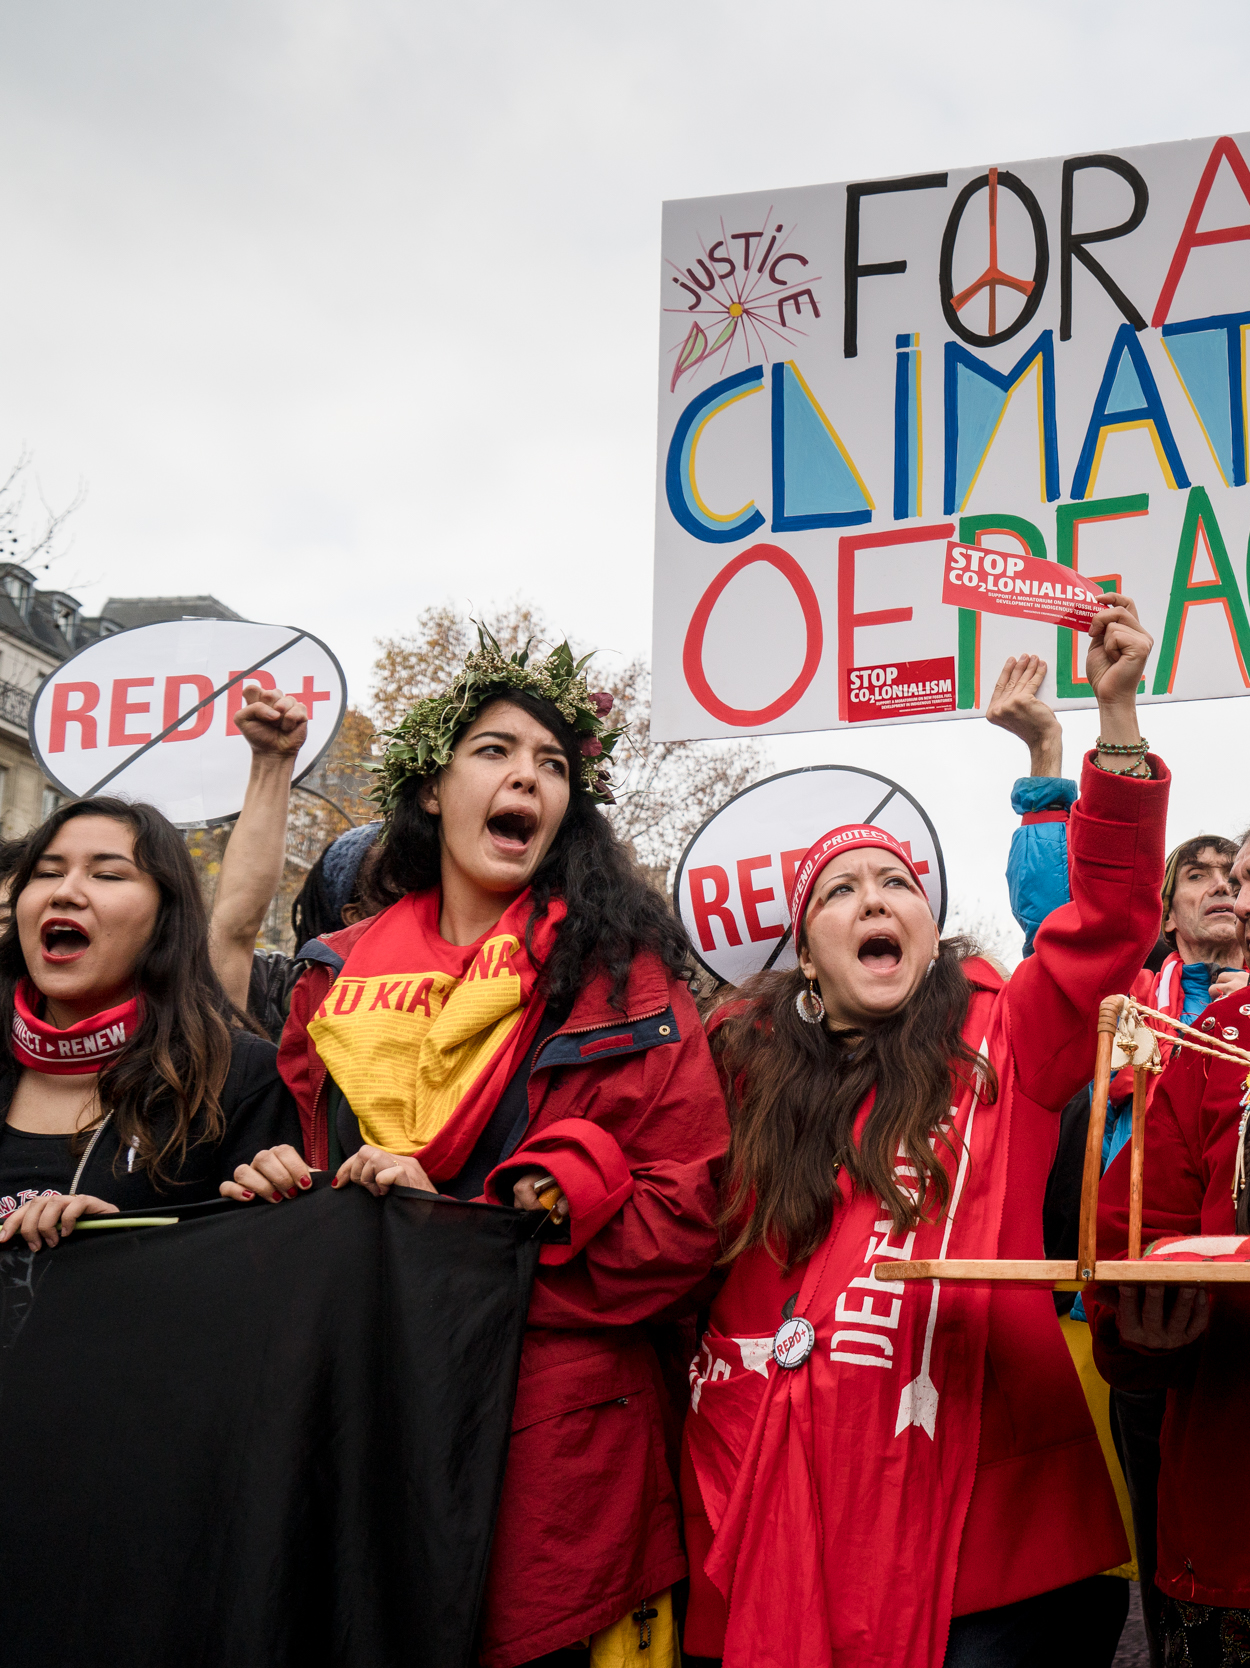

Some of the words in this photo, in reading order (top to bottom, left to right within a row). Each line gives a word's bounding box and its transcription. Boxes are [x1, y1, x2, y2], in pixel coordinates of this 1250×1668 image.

[845, 154, 1149, 357] FOR
[950, 547, 1025, 577] STOP
[988, 592, 1011, 600] SUPPORT
[1018, 596, 1053, 604] MORATORIUM
[1076, 603, 1092, 611] FOSSIL
[996, 599, 1034, 607] DEVELOPMENT
[1041, 604, 1073, 614] INDIGENOUS
[682, 523, 956, 725] OF
[850, 667, 898, 689] STOP
[822, 829, 889, 852] PROTECT
[58, 1022, 126, 1056] RENEW
[776, 1328, 807, 1358] REDD+
